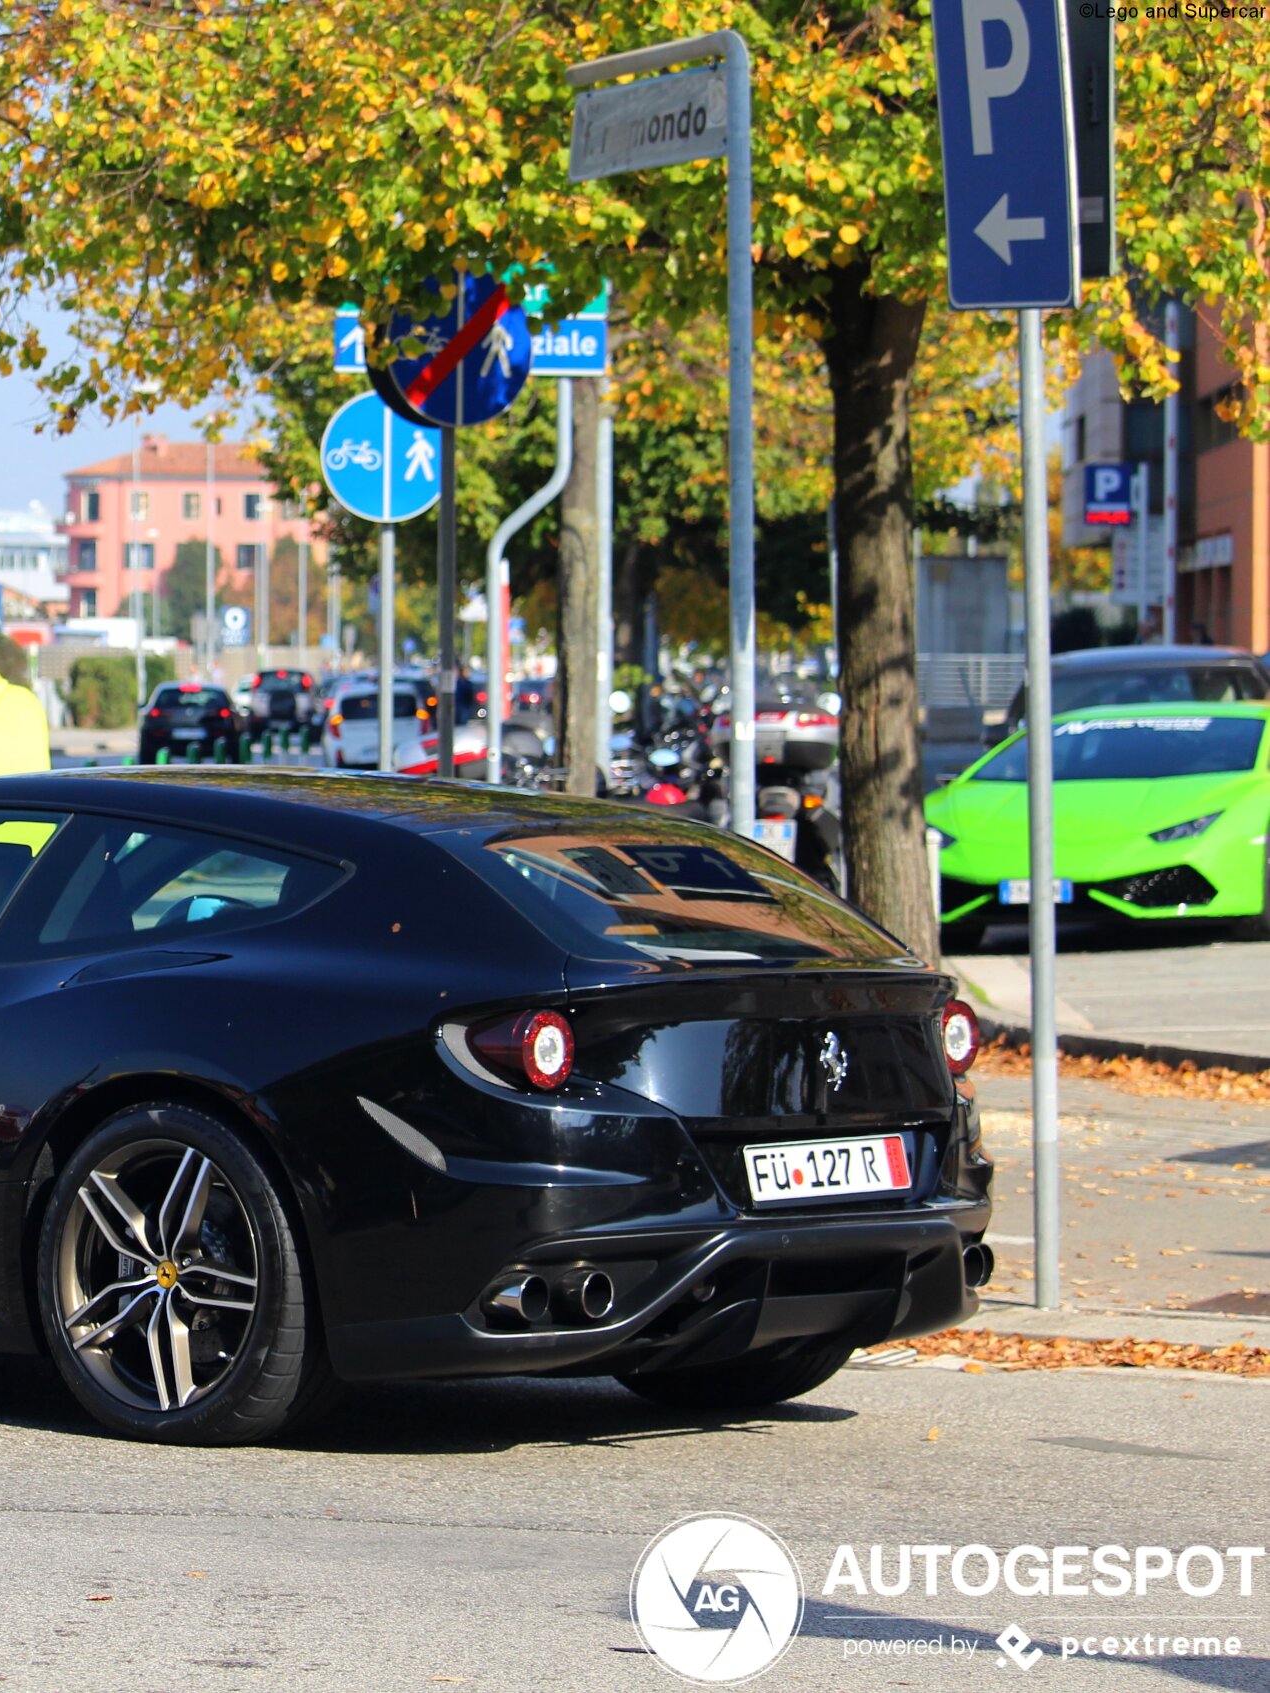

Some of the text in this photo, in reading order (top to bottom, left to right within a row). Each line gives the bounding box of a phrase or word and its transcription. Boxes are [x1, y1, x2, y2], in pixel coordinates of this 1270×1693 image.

[962, 0, 1031, 155] P
[1095, 468, 1123, 500] P
[806, 1147, 851, 1188] 127
[861, 1146, 881, 1183] R
